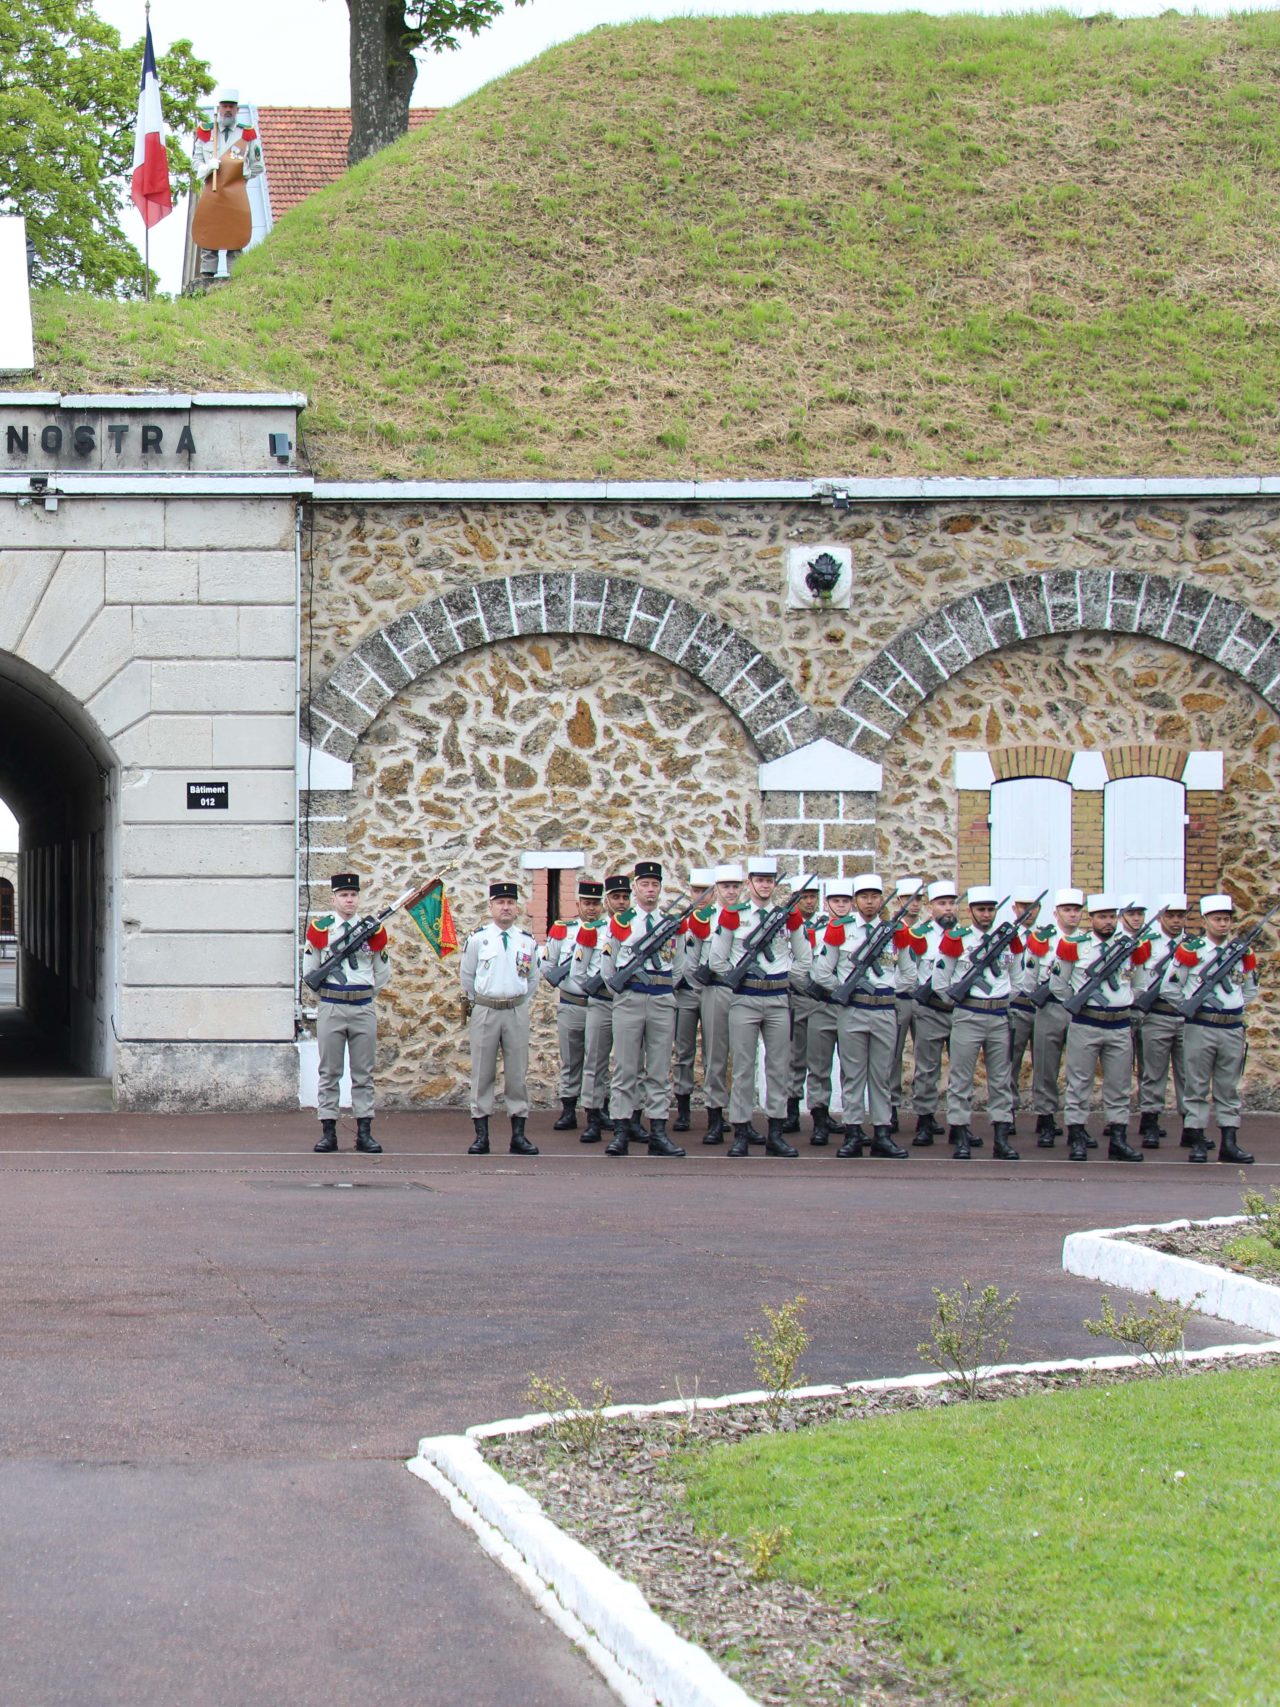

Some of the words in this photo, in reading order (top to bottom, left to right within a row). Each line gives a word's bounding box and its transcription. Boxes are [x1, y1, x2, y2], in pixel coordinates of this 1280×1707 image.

[6, 424, 197, 455] NOSTRA
[190, 785, 225, 794] Bâtiment
[200, 798, 216, 806] 012
